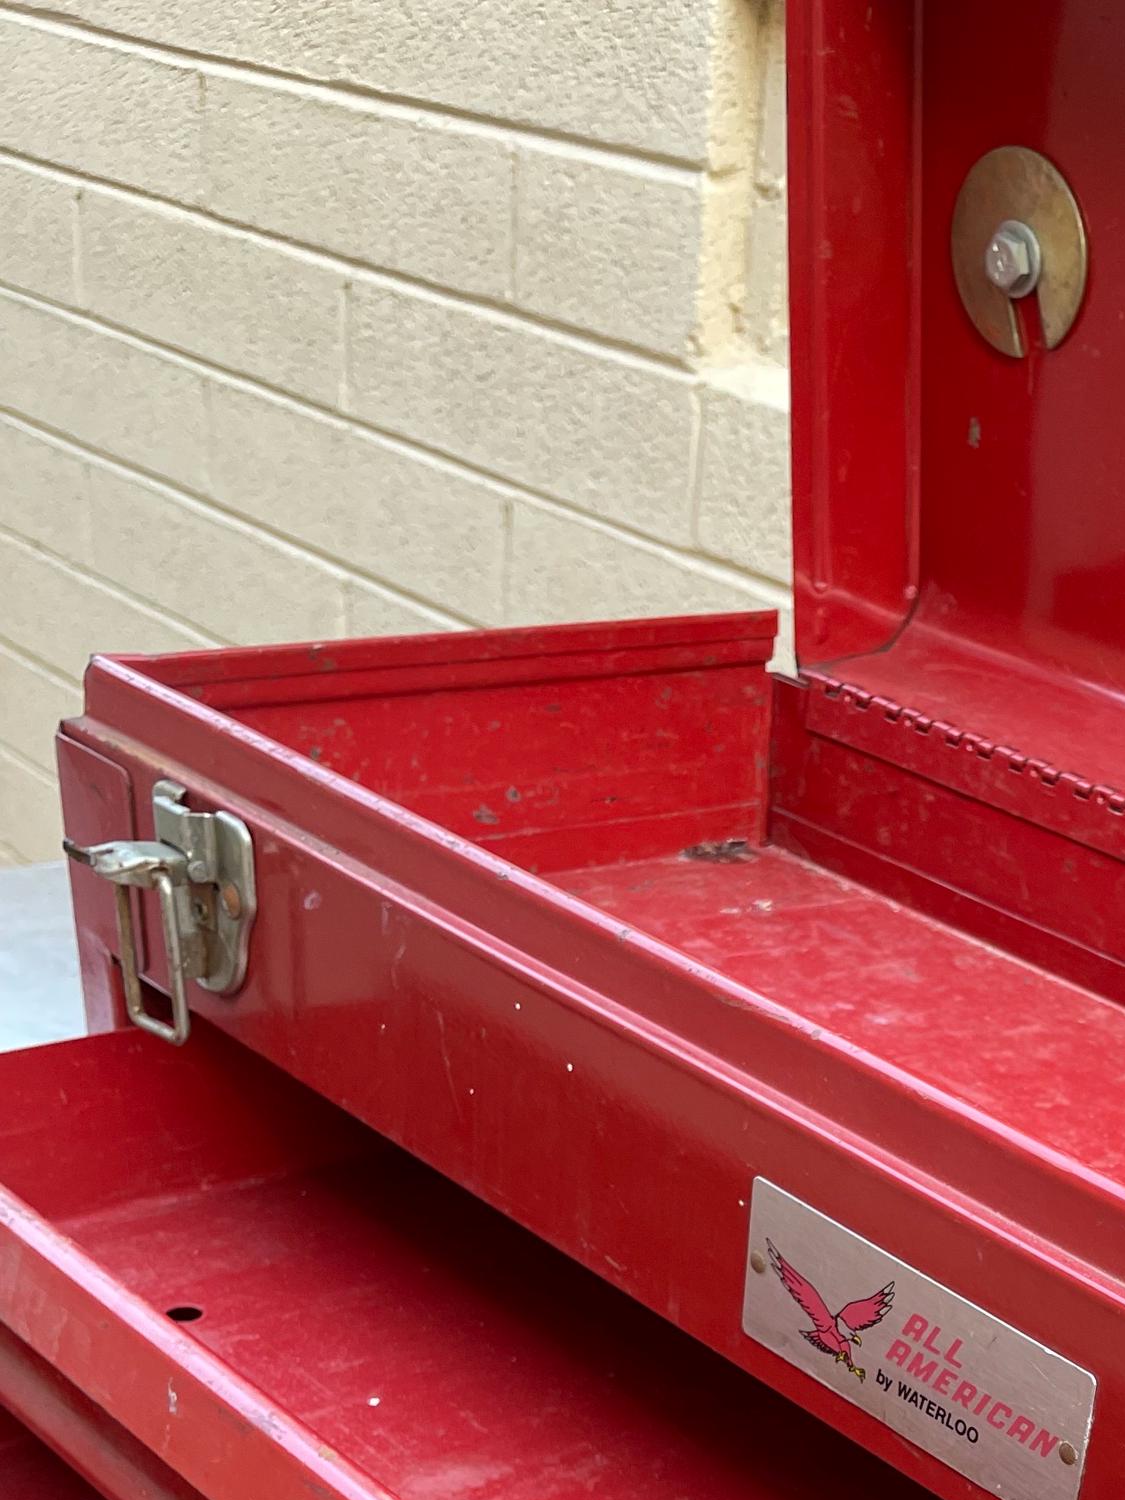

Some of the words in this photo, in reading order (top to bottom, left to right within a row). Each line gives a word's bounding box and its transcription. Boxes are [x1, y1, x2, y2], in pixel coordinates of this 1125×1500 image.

[901, 1313, 963, 1369] ALL
[875, 1369, 893, 1392] by
[897, 1383, 979, 1444] WATERLOO
[885, 1339, 1060, 1458] AMERICAN
